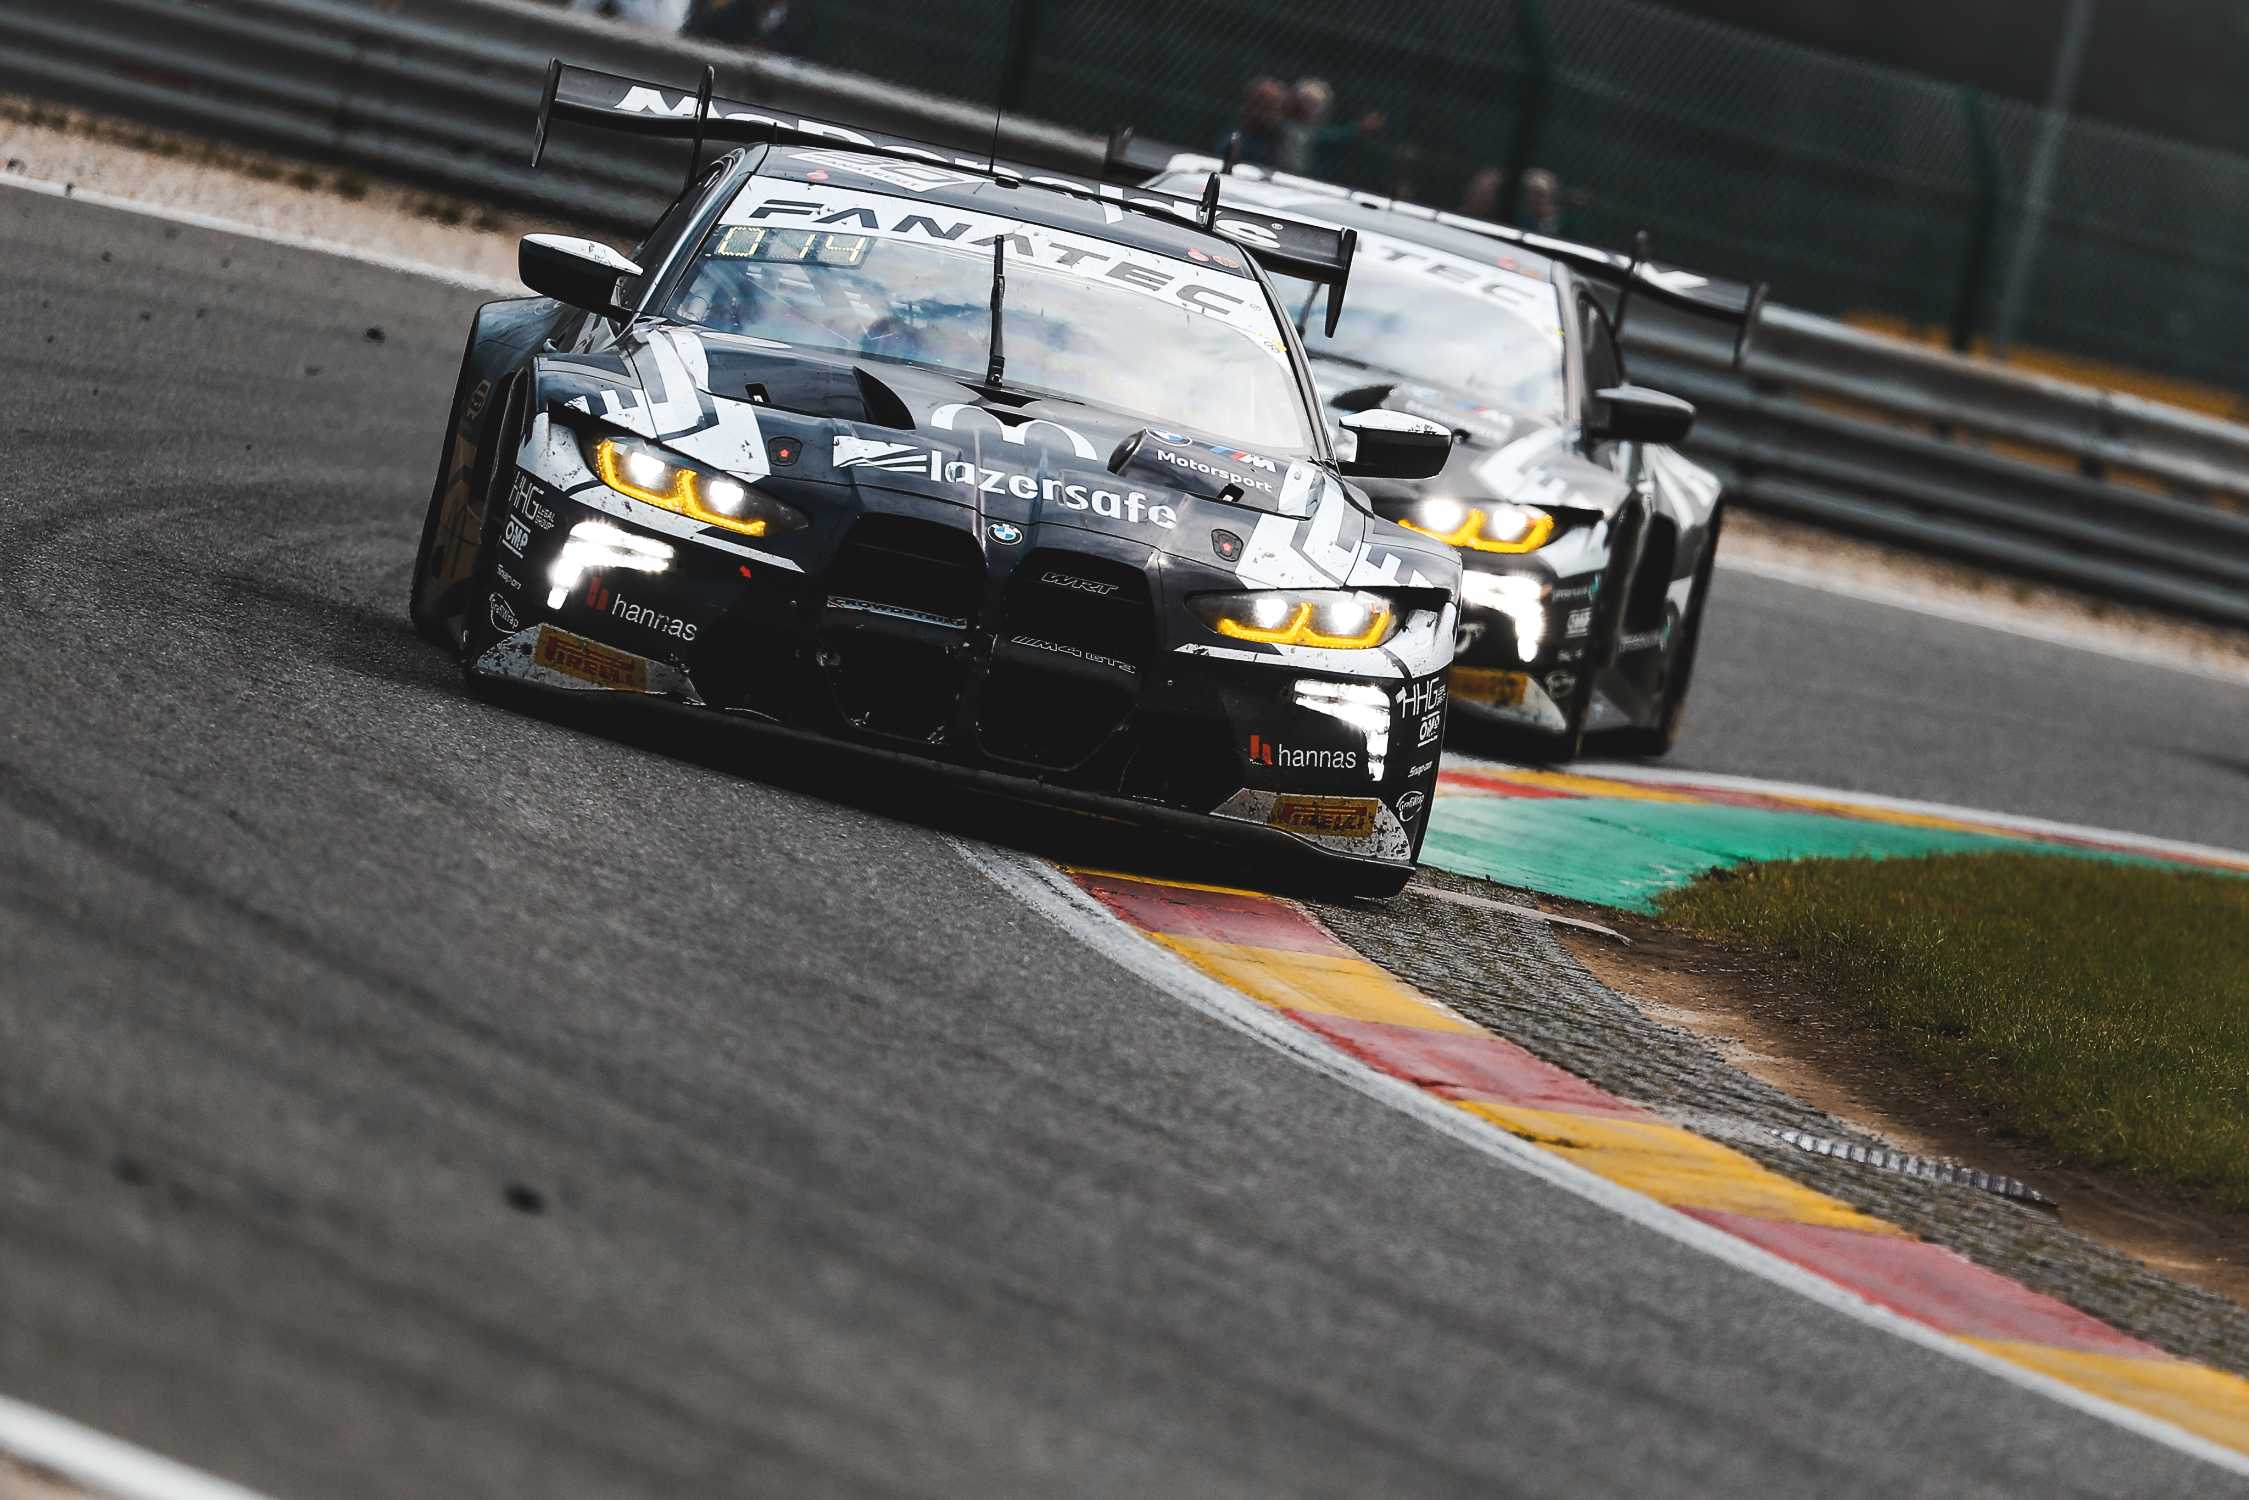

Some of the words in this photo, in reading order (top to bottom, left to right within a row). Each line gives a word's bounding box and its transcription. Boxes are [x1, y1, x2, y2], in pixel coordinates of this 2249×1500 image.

[748, 199, 1245, 316] FANATEC
[930, 449, 1177, 528] lazersafe
[1157, 449, 1272, 493] Motorsport
[505, 520, 529, 551] OMP
[1041, 571, 1119, 595] WRT
[611, 593, 698, 641] hannas
[1402, 677, 1440, 718] HHG
[1278, 743, 1357, 769] hannas
